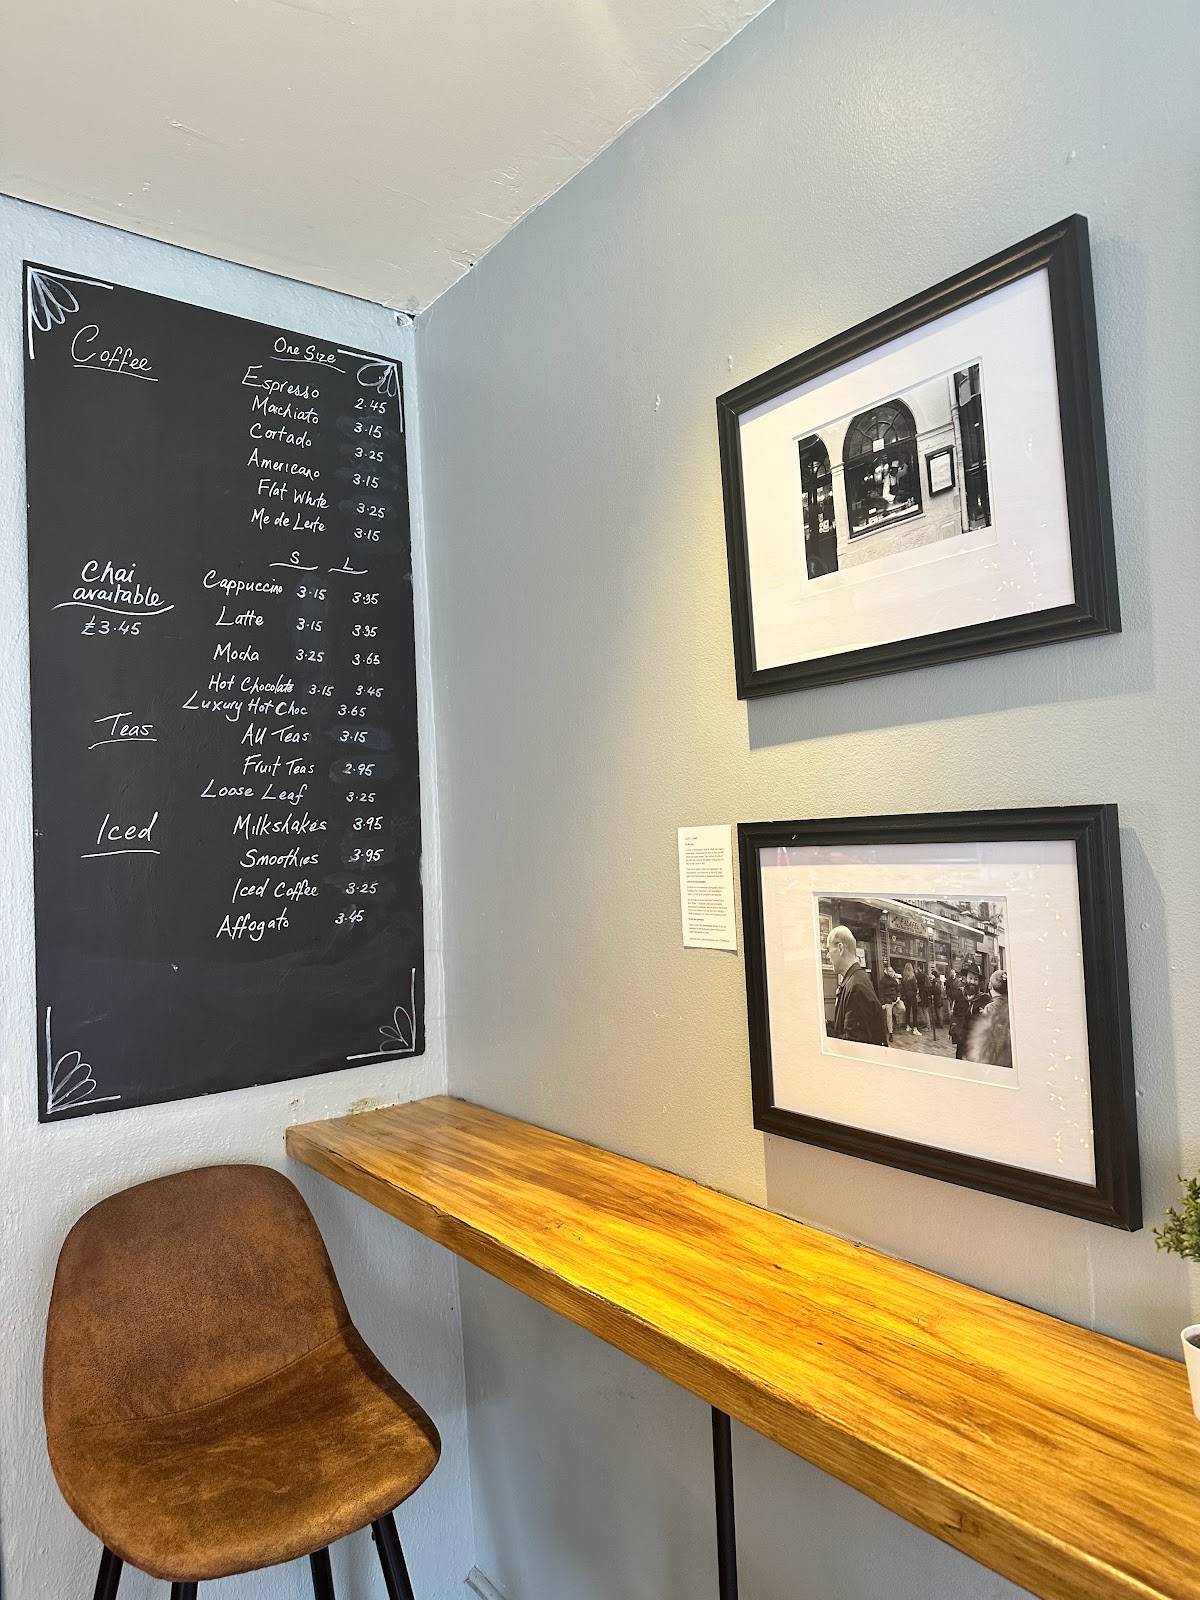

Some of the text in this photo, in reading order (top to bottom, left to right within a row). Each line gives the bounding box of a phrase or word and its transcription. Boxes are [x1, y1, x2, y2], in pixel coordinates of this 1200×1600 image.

[71, 325, 152, 372] Coffee
[274, 337, 336, 365] One Size
[242, 365, 320, 399] Espresso
[249, 423, 312, 448] Cortado
[247, 448, 320, 481] Americano
[258, 479, 288, 500] Flat
[293, 490, 329, 510] White
[251, 509, 272, 533] Me
[274, 513, 290, 528] de
[81, 560, 137, 584] Chai
[291, 551, 354, 571] S L
[72, 586, 165, 608] available
[215, 606, 265, 626] Latte
[213, 642, 260, 662] Mocha
[208, 675, 235, 692] Hot
[240, 675, 295, 694] Chocolate
[182, 691, 243, 721] Luxury
[248, 698, 274, 717] Hot
[275, 702, 308, 717] Choc
[94, 712, 153, 737] Teas
[241, 722, 266, 746] All
[270, 724, 310, 744] Teas
[242, 755, 283, 777] Fruit
[286, 758, 315, 776] Teas
[201, 780, 254, 799] Loose
[262, 784, 308, 806] Leaf
[98, 811, 159, 844] Iced
[233, 811, 327, 840] Milkshakes
[240, 846, 319, 868] Smoothies
[233, 878, 270, 903] Iced
[274, 879, 320, 901] Coffee
[216, 908, 289, 941] Affogato
